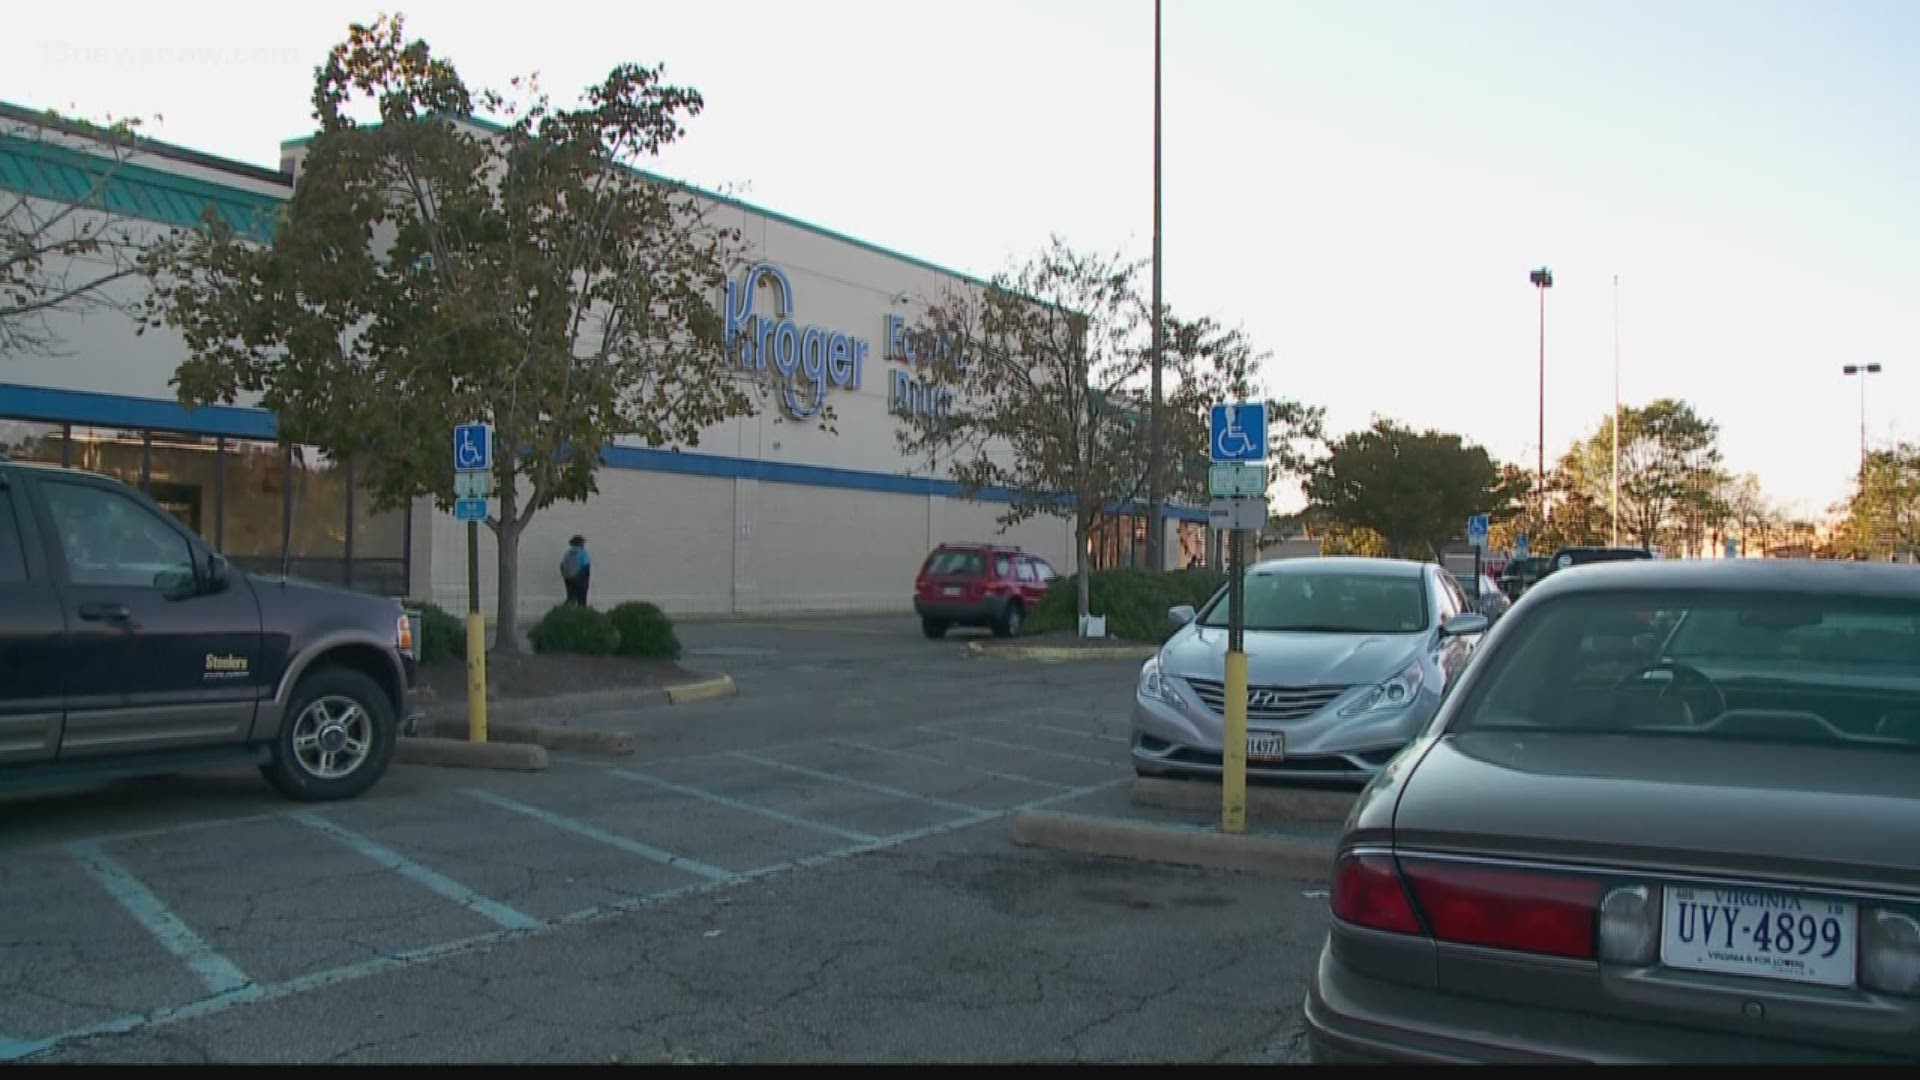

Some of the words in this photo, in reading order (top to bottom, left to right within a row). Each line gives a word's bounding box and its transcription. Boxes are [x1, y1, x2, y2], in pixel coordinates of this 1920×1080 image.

[724, 263, 869, 420] Kroger
[1714, 887, 1802, 911] VIRGINIA
[1678, 901, 1842, 960] UVY-4899
[1707, 951, 1744, 961] VIRGINIA
